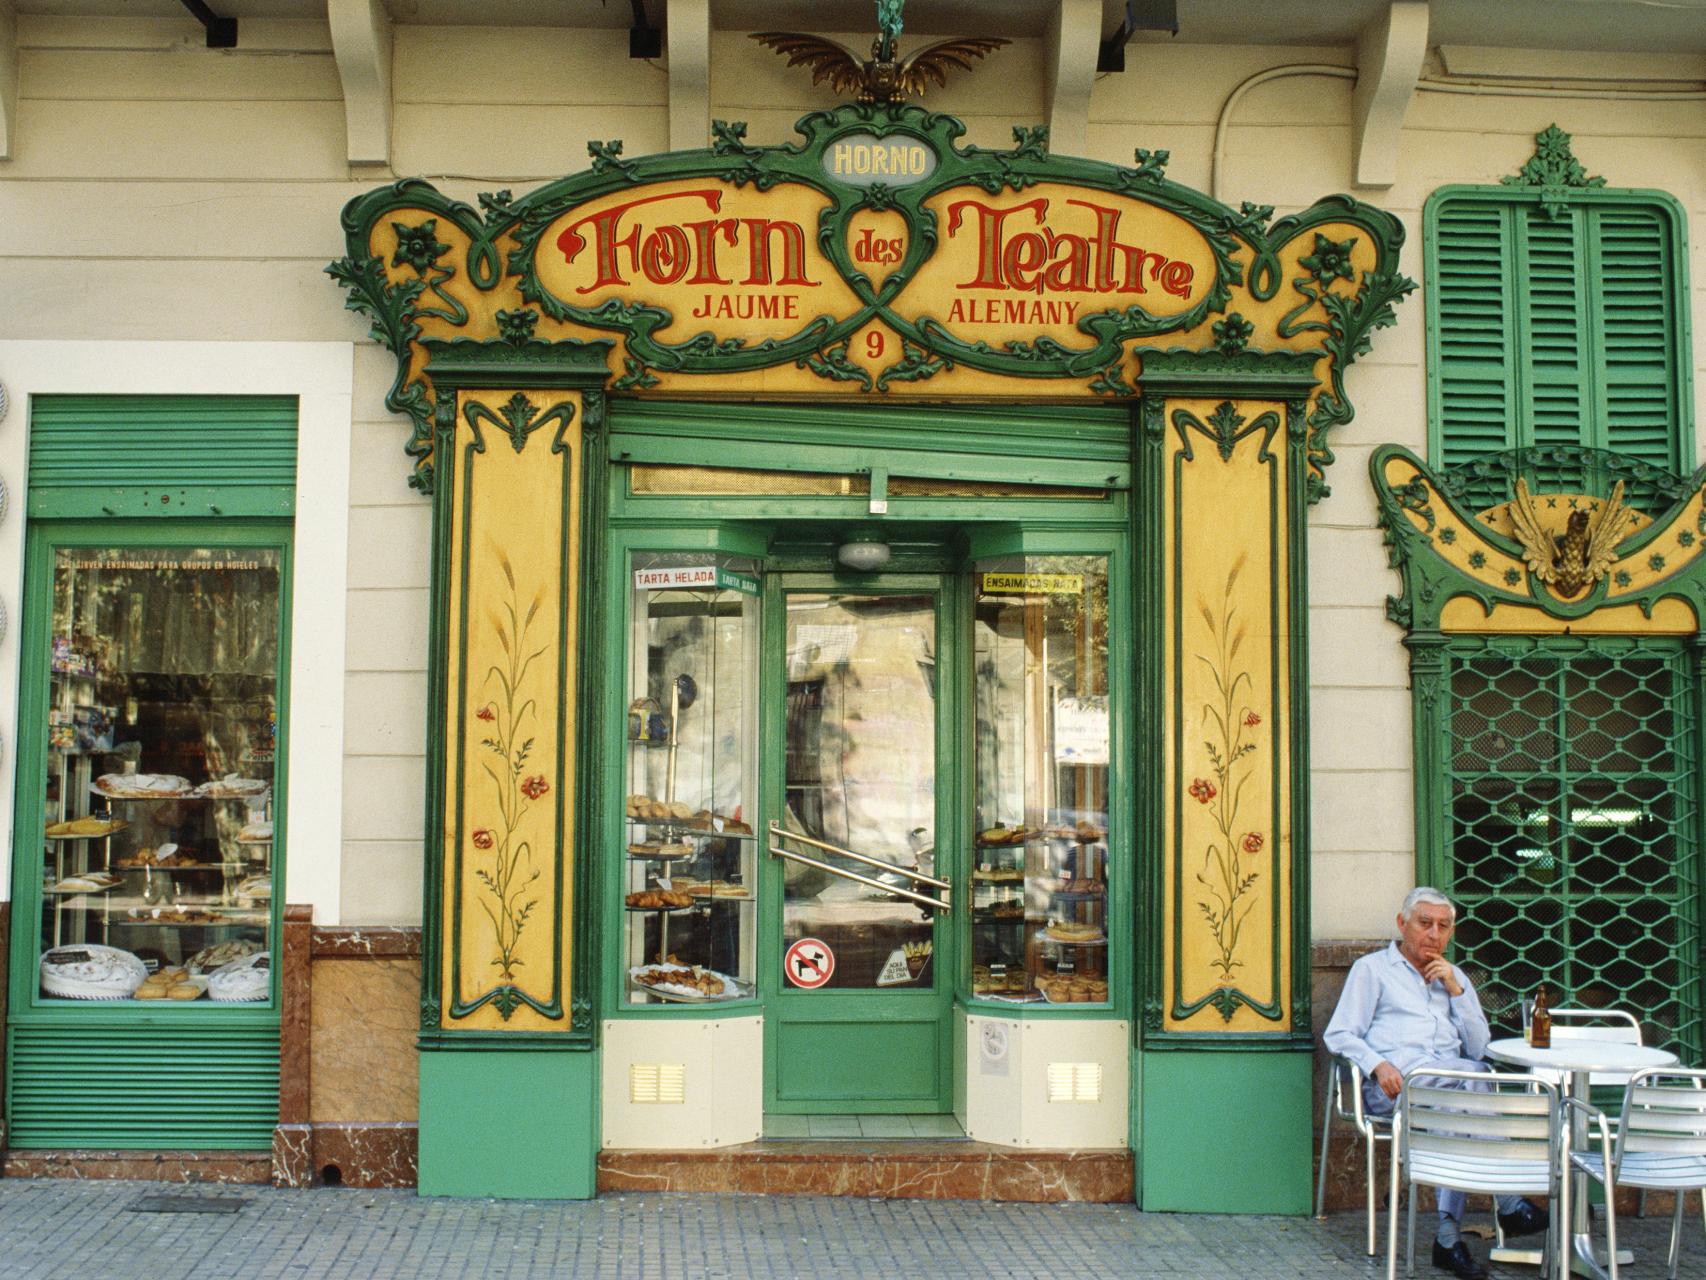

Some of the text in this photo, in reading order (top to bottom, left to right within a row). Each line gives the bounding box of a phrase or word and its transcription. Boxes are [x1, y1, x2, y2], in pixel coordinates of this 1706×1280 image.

[833, 144, 927, 176] HORNO
[556, 189, 1195, 300] Forn des Teatre
[692, 295, 800, 320] JAUME
[947, 299, 1081, 325] ALEMANY
[865, 330, 885, 359] 9
[158, 560, 179, 569] PARA
[227, 560, 259, 570] HOTELES
[638, 571, 715, 584] TARTA HELADA
